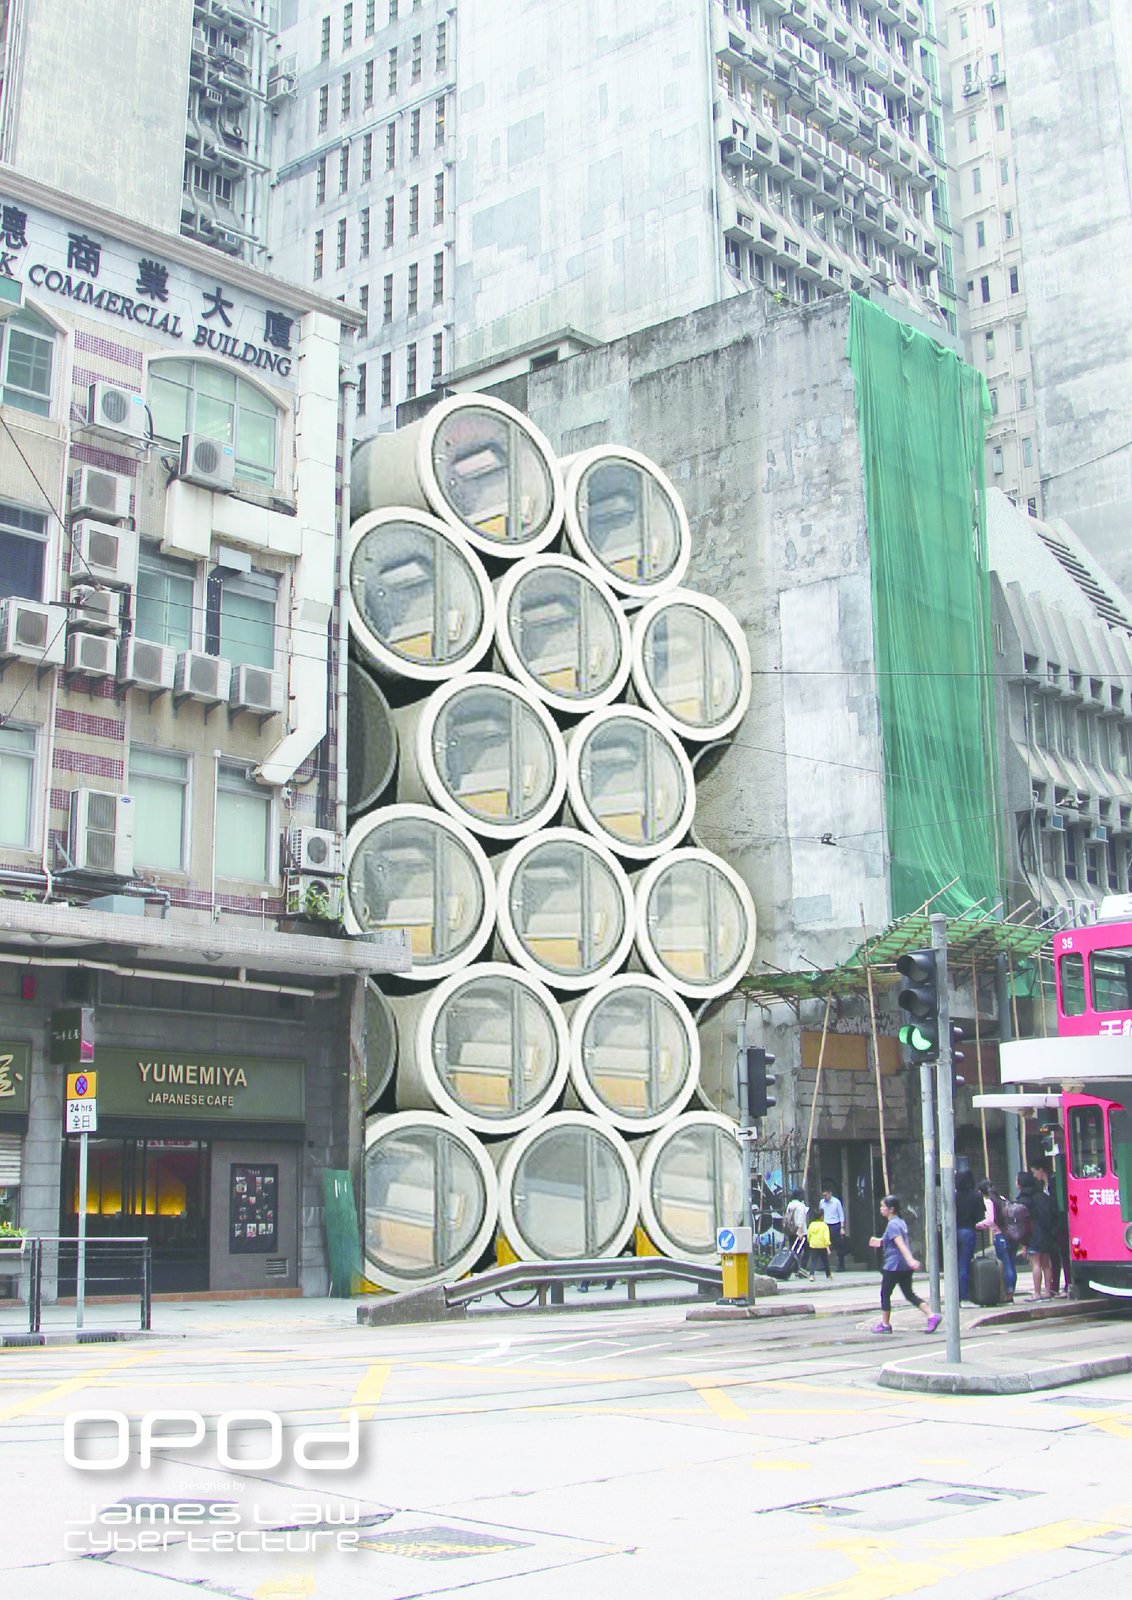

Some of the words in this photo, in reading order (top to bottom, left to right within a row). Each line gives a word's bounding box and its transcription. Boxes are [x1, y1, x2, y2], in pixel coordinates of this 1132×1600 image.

[28, 264, 183, 338] COMMERCIAL
[192, 324, 292, 378] BUILDING
[1062, 938, 1073, 949] 35
[138, 1062, 248, 1087] YUMEMIYA
[148, 1093, 204, 1105] JAPANESE
[206, 1095, 234, 1107] CAFE
[70, 1104, 79, 1112] 24
[81, 1103, 92, 1112] hrs
[72, 1115, 90, 1129] 全日
